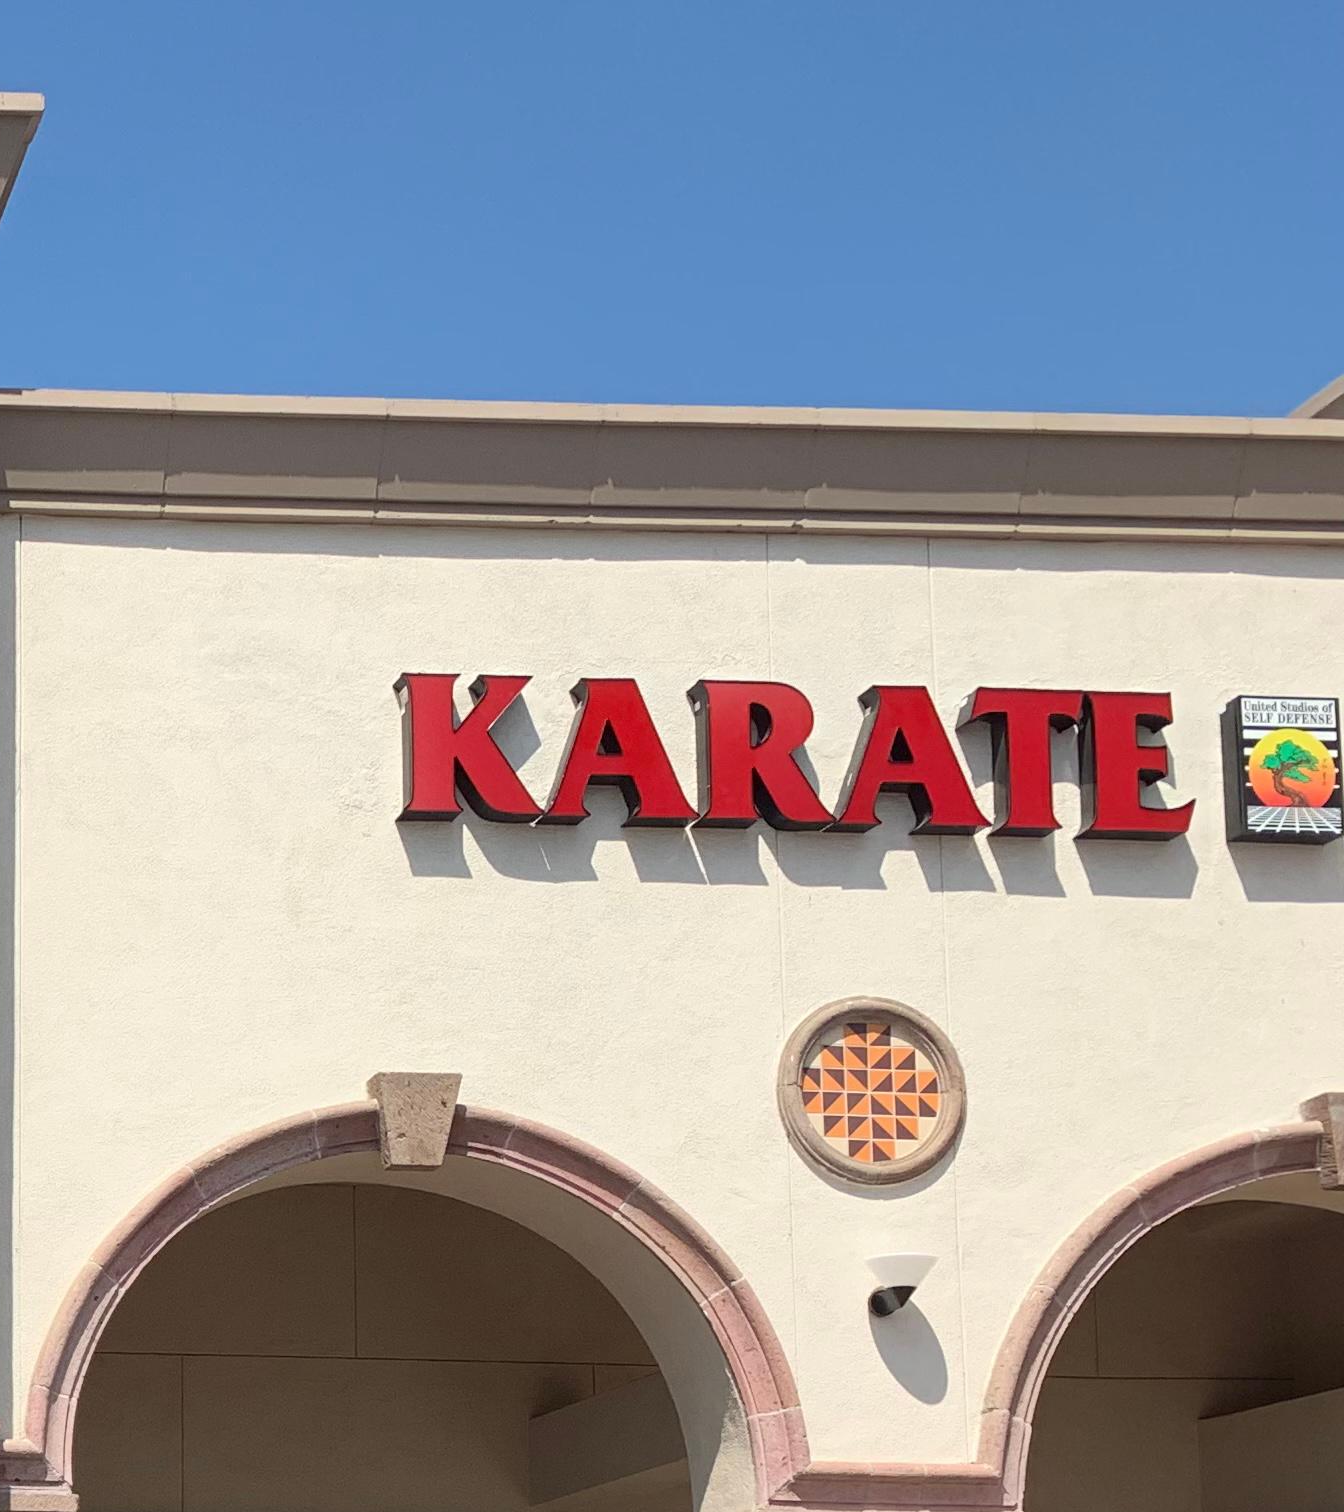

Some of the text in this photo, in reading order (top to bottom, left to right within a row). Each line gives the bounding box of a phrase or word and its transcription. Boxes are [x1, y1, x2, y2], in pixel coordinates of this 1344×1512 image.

[1243, 700, 1334, 713] United Studios of
[1244, 712, 1334, 725] SELF DEFENSE
[394, 672, 1197, 842] KARATE
